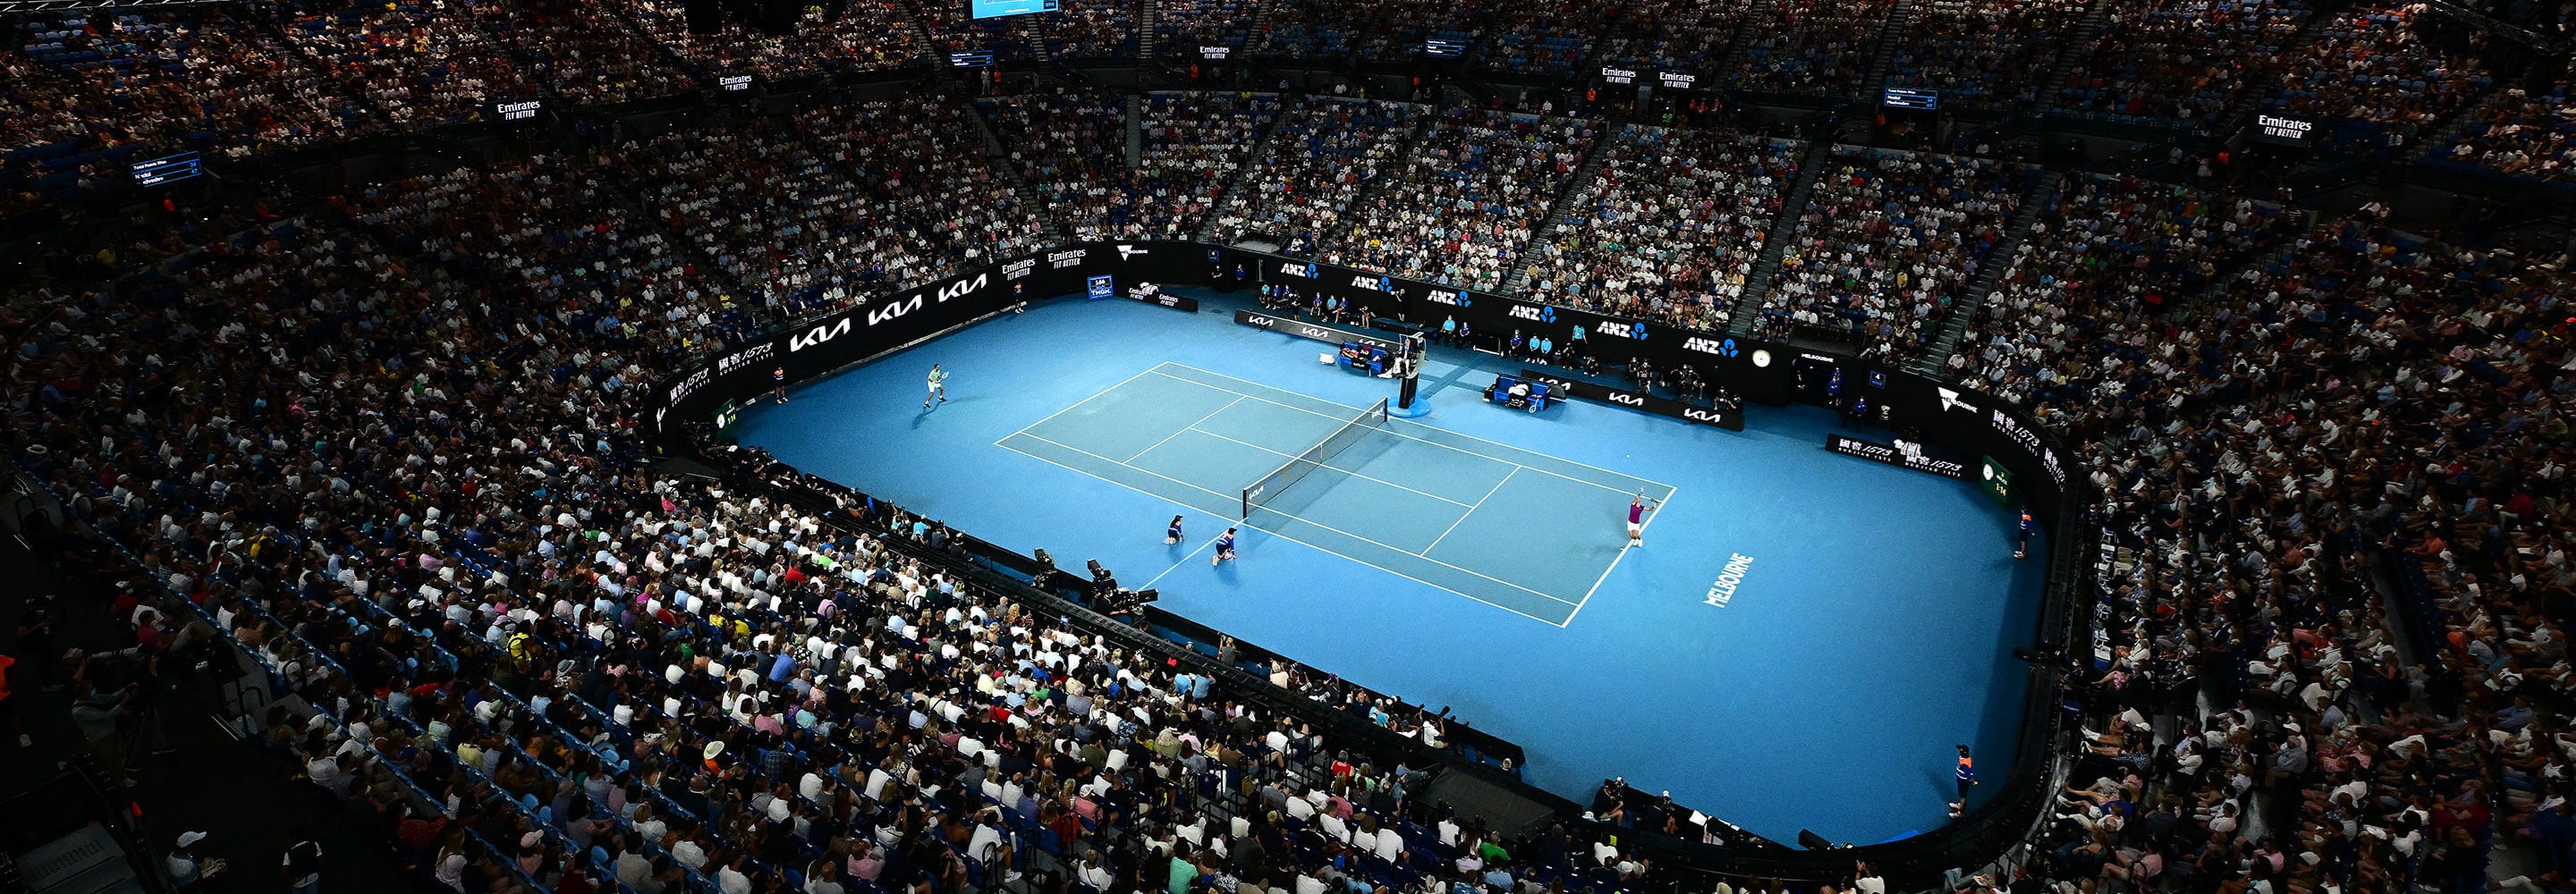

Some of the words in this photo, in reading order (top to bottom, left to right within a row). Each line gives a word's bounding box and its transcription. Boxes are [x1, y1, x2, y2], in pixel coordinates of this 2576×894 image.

[719, 75, 751, 85] Emirates
[1603, 68, 1636, 78] Emirates
[1660, 72, 1695, 82] Emirates
[497, 101, 540, 113] Emirates
[505, 113, 514, 121] FLY
[2258, 114, 2312, 131] Emirates
[2264, 126, 2276, 135] FLY
[2276, 128, 2302, 139] BETTER
[1047, 249, 1086, 262] Emirates
[1002, 258, 1036, 274] Emirates
[1054, 260, 1062, 269] FLY
[1280, 263, 1306, 277] ANZ
[1352, 275, 1378, 291] ANZ
[1428, 290, 1456, 306] ANZ
[1509, 304, 1540, 321] ANZ
[1597, 321, 1631, 338] ANZ
[1682, 337, 1719, 355] ANZ
[1702, 552, 1754, 608] MELBOURNE
